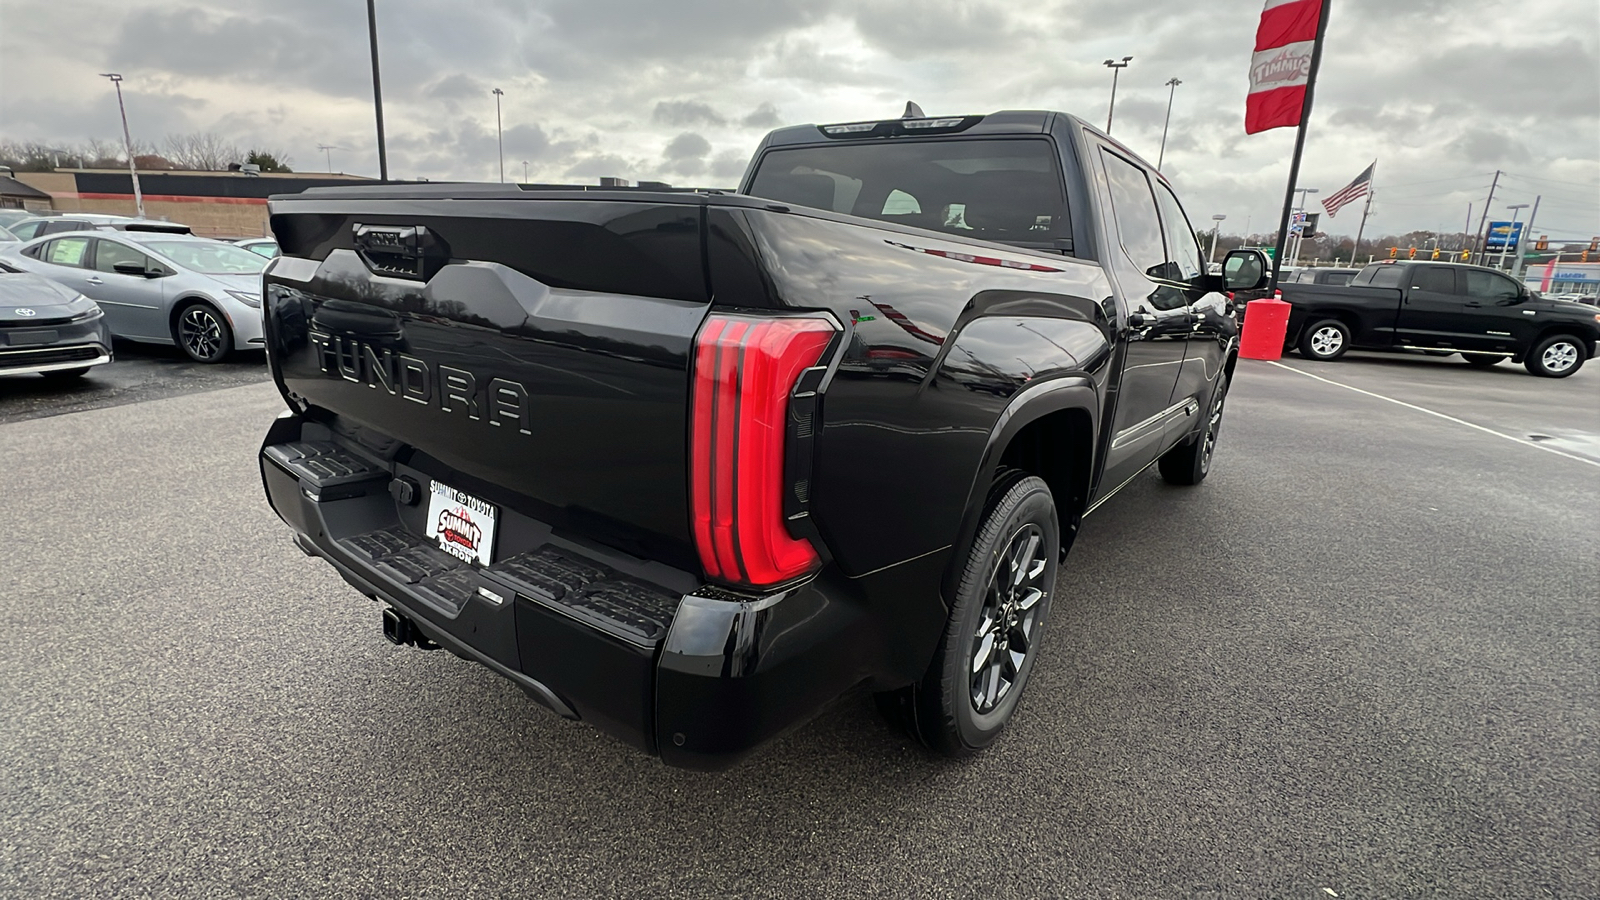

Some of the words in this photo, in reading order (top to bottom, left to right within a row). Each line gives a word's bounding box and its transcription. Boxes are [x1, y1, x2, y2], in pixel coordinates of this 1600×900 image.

[308, 331, 532, 435] TUNDRA
[430, 480, 458, 502] SUMMIT
[467, 495, 494, 519] TOYOTA
[438, 510, 481, 551] SUMMIT
[454, 534, 473, 549] TOYOTA
[439, 542, 472, 565] AKRON
